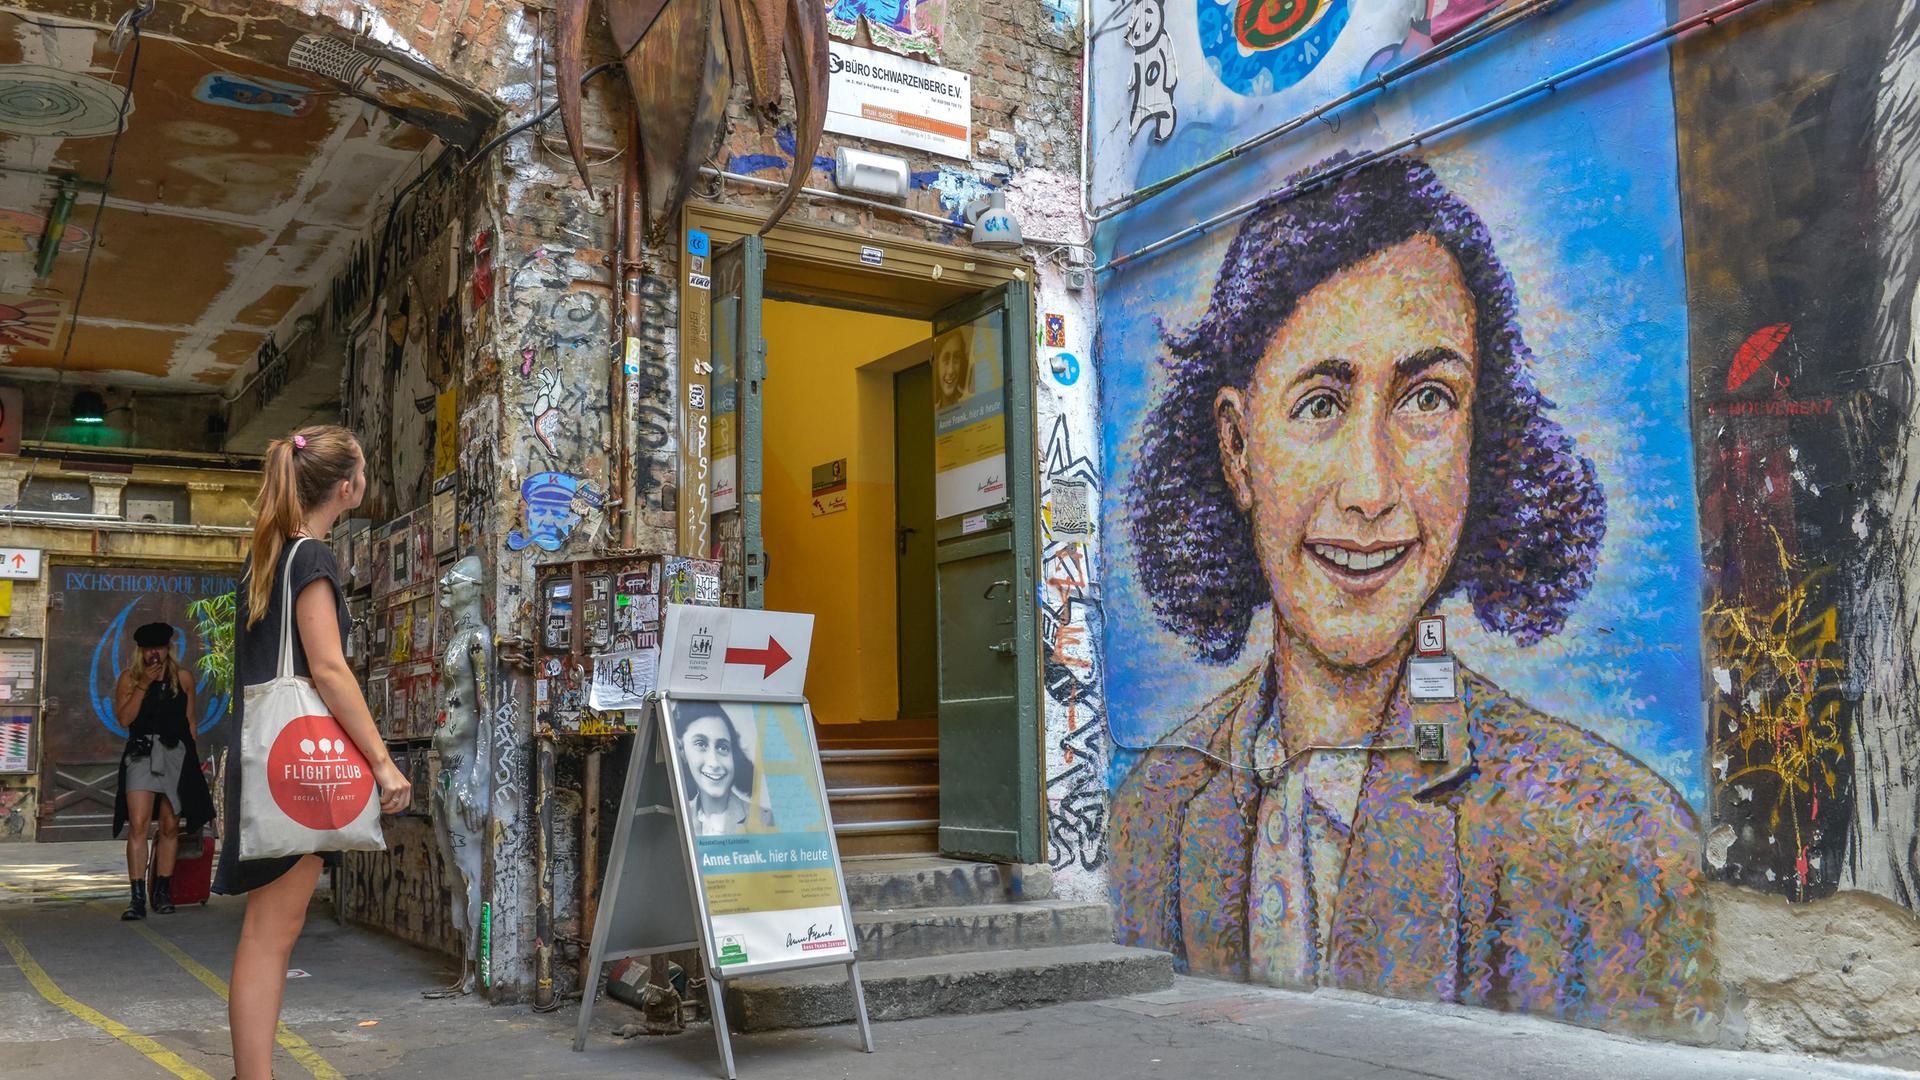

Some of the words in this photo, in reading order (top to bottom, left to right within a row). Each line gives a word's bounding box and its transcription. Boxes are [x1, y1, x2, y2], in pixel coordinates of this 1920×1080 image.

[845, 59, 870, 77] BÜRO
[872, 66, 946, 95] SCHWARZENBERG
[948, 85, 962, 99] E.V.
[548, 474, 559, 484] K
[284, 764, 331, 780] FLIGHT
[335, 764, 362, 779] CLUB
[703, 852, 731, 867] Anne
[732, 849, 767, 865] Frank.
[769, 849, 788, 863] hier
[790, 849, 798, 861] &
[800, 848, 829, 862] heute
